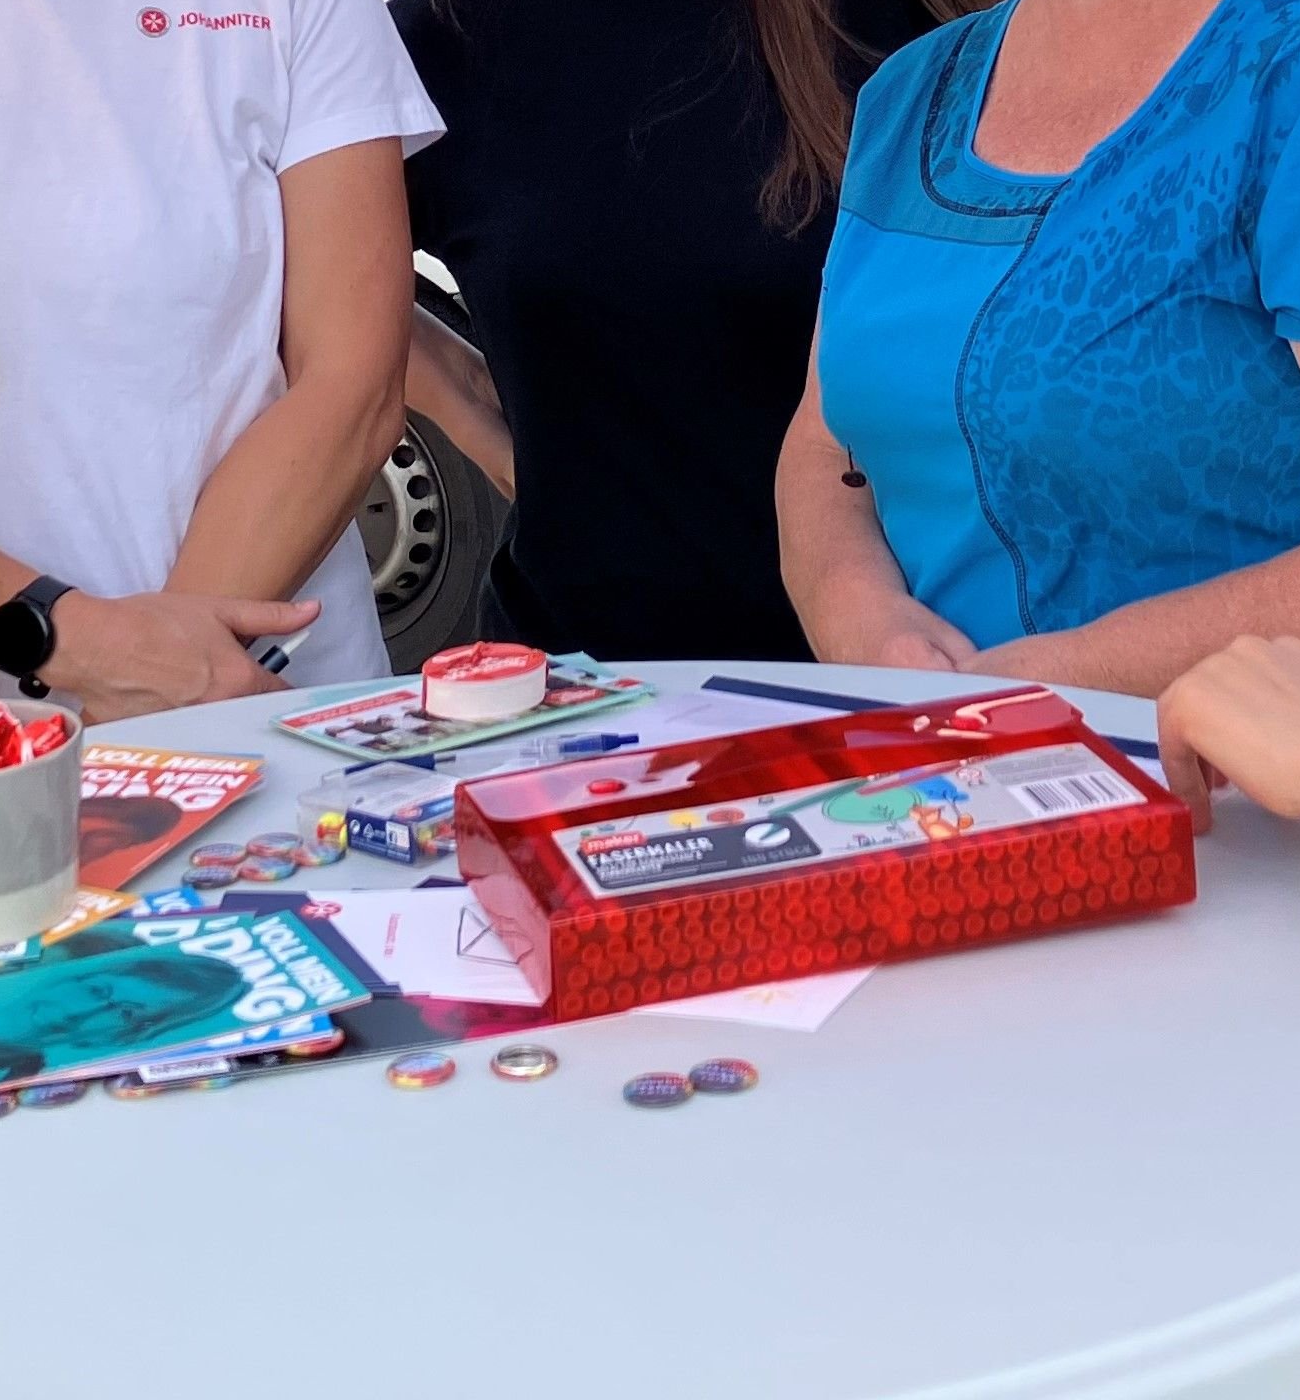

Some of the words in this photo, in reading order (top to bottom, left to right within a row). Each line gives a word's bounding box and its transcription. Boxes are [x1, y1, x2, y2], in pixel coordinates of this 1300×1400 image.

[177, 12, 271, 31] JOHANNITER
[82, 747, 160, 768] VOLL
[161, 755, 251, 771] MEIN
[153, 771, 249, 789] MEIN
[587, 837, 714, 867] FASERMALER
[251, 916, 309, 964] VOLL
